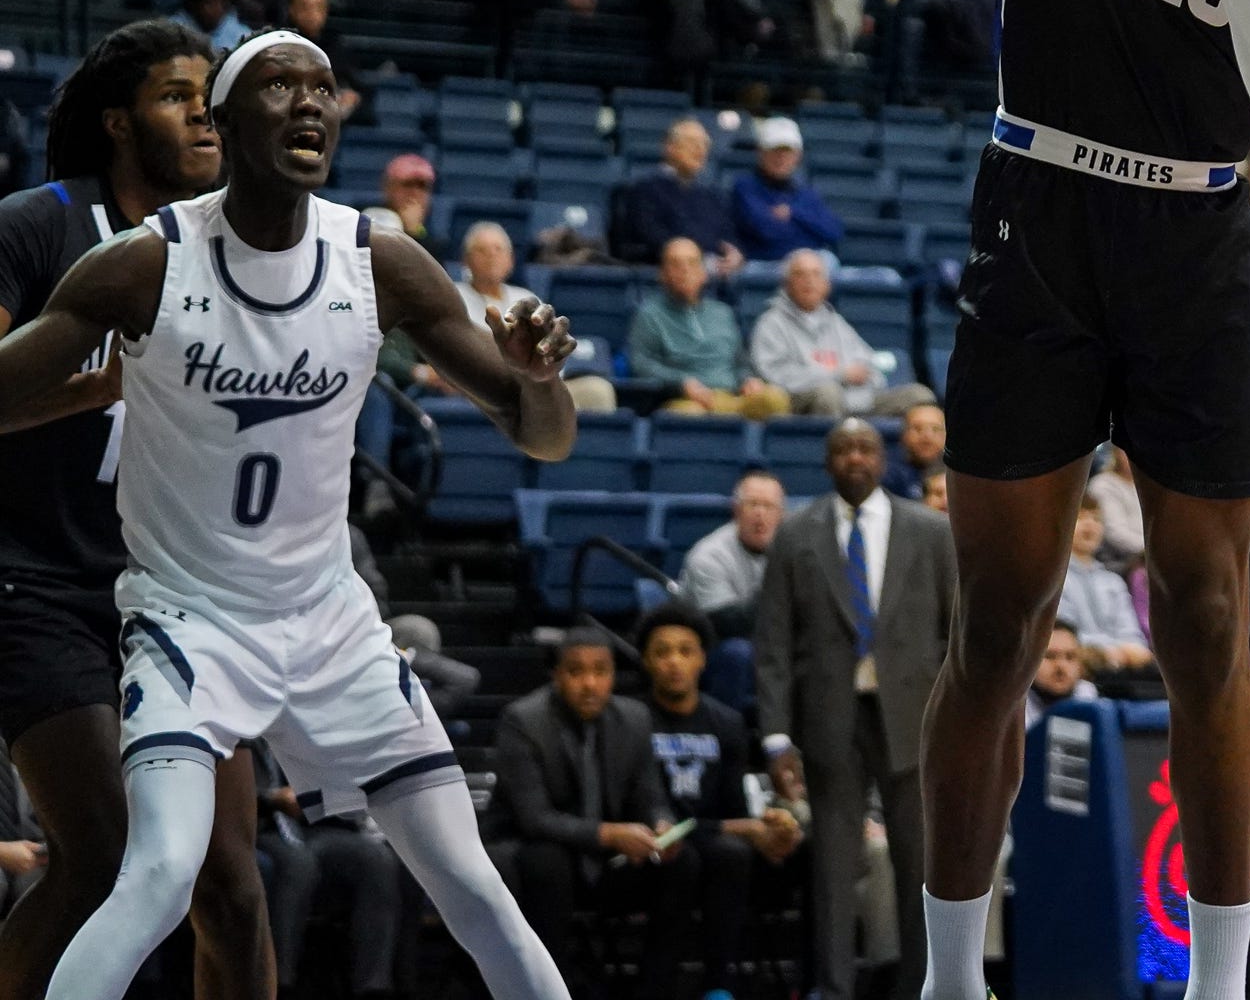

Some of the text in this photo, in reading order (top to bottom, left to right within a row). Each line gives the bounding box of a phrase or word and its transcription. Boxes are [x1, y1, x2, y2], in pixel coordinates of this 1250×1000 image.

[1072, 143, 1174, 185] PIRATES
[328, 301, 353, 312] CAA
[184, 341, 349, 398] Hawks
[231, 451, 282, 528] 0
